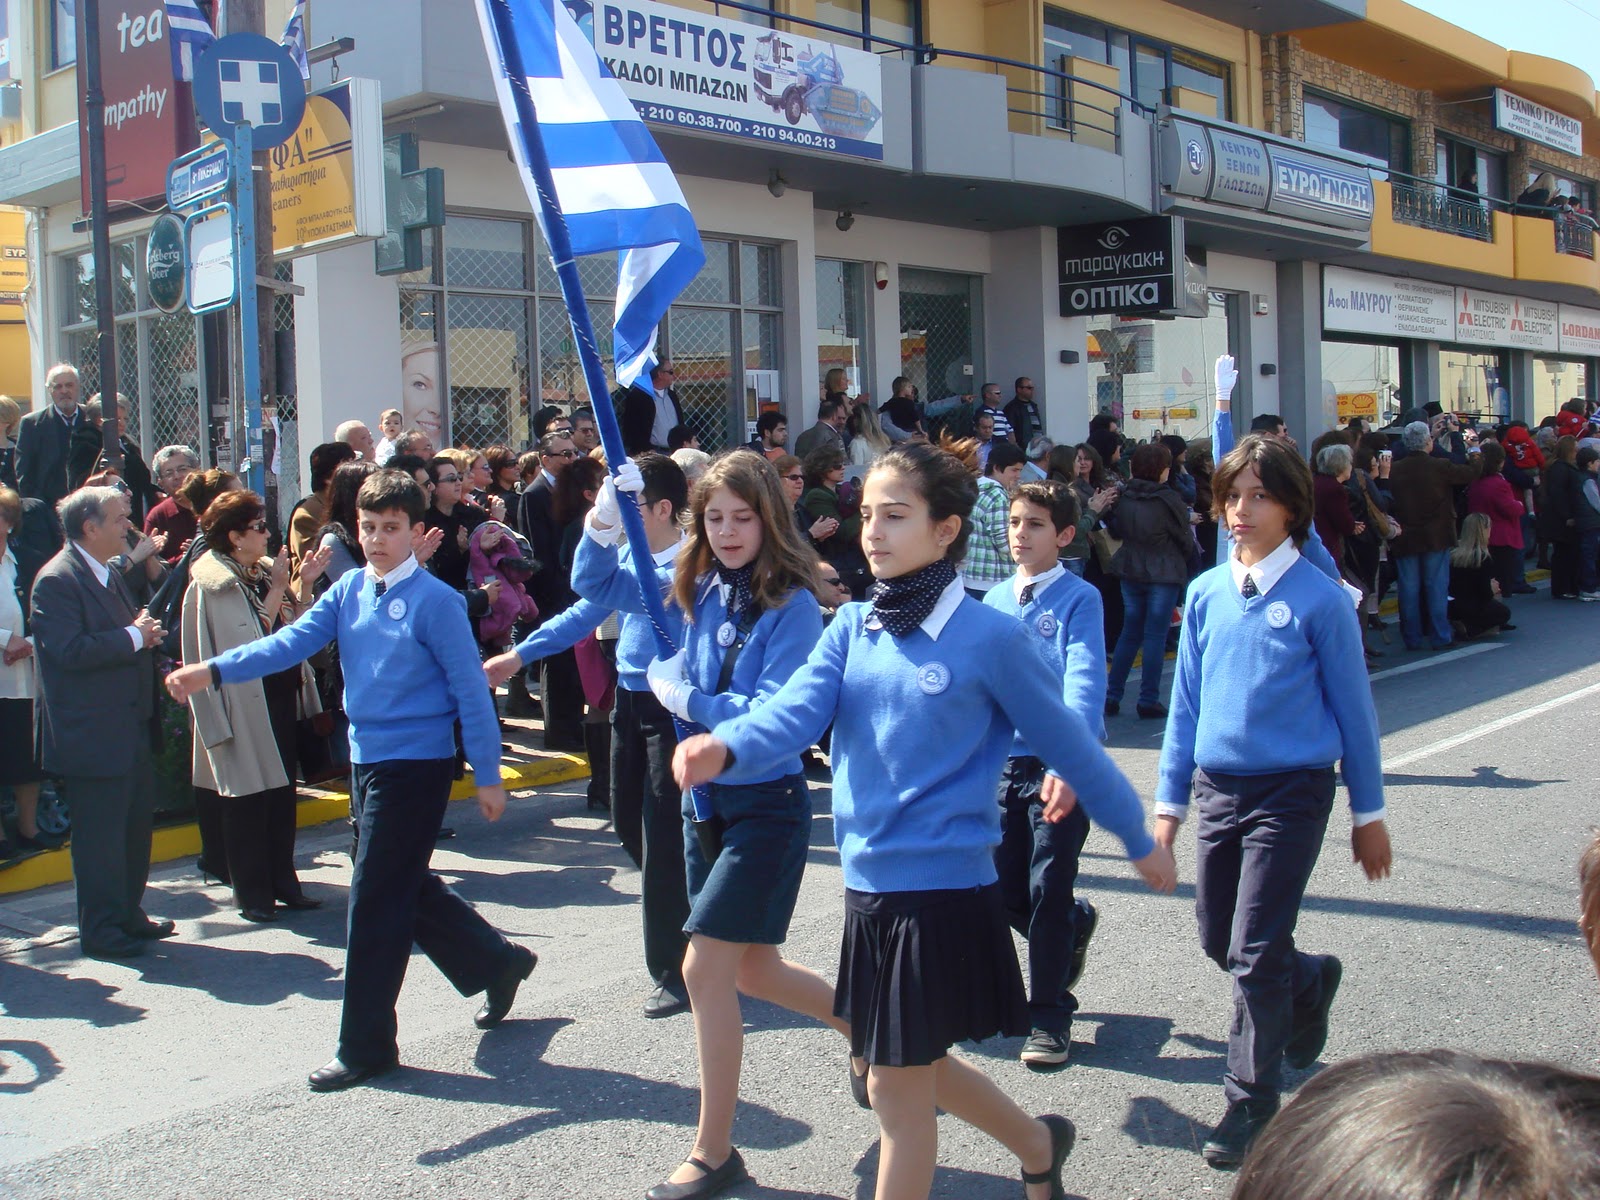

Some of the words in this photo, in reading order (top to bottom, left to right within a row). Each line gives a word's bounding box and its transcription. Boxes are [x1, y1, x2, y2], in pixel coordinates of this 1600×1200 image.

[117, 9, 163, 53] tea
[604, 5, 746, 72] ΒΡΕΤΤΟΣ
[603, 57, 663, 88] ΚΑΔΟΙ
[670, 70, 748, 103] ΜΠΑΖΩΝ
[104, 84, 167, 130] mpathy
[1504, 94, 1542, 121] ΤΕΧΝΙΚΟ
[1544, 110, 1580, 136] ΓΡΑΦΕΙΟ
[648, 106, 675, 121] 210
[677, 112, 742, 133] 60.38.700
[752, 124, 776, 139] 210
[778, 128, 836, 150] 94.00.213
[271, 127, 313, 172] ΦΑ"
[1220, 140, 1261, 160] ΚΕΝΤΡΟ
[1226, 158, 1260, 176] ΞΕΝΩΝ
[1218, 175, 1265, 197] ΓΛΩΣΣΩΝ
[1278, 165, 1369, 212] ΕΥΡΩΓΝΩΣΗ
[273, 194, 302, 211] eaners
[5, 248, 27, 258] ΕΥΡ
[1350, 290, 1392, 314] ΜΑΥΡΟΥ
[1397, 294, 1434, 305] ΚΛΙΜΑΤΙΣΜΟΥ
[1397, 303, 1429, 314] ΘΕΡΜΑΝΣΗΣ
[1473, 298, 1511, 316] MITSUBISHI
[1420, 316, 1448, 326] ΕΝΕΡΓΕΙΑΣ
[1473, 314, 1506, 330] ELECTRIC
[1523, 306, 1556, 322] MITSUBISHI
[1458, 328, 1496, 341] ΚΛΙΜΑΤΙΣΜΟΣ
[1524, 320, 1553, 336] ELECTRIC
